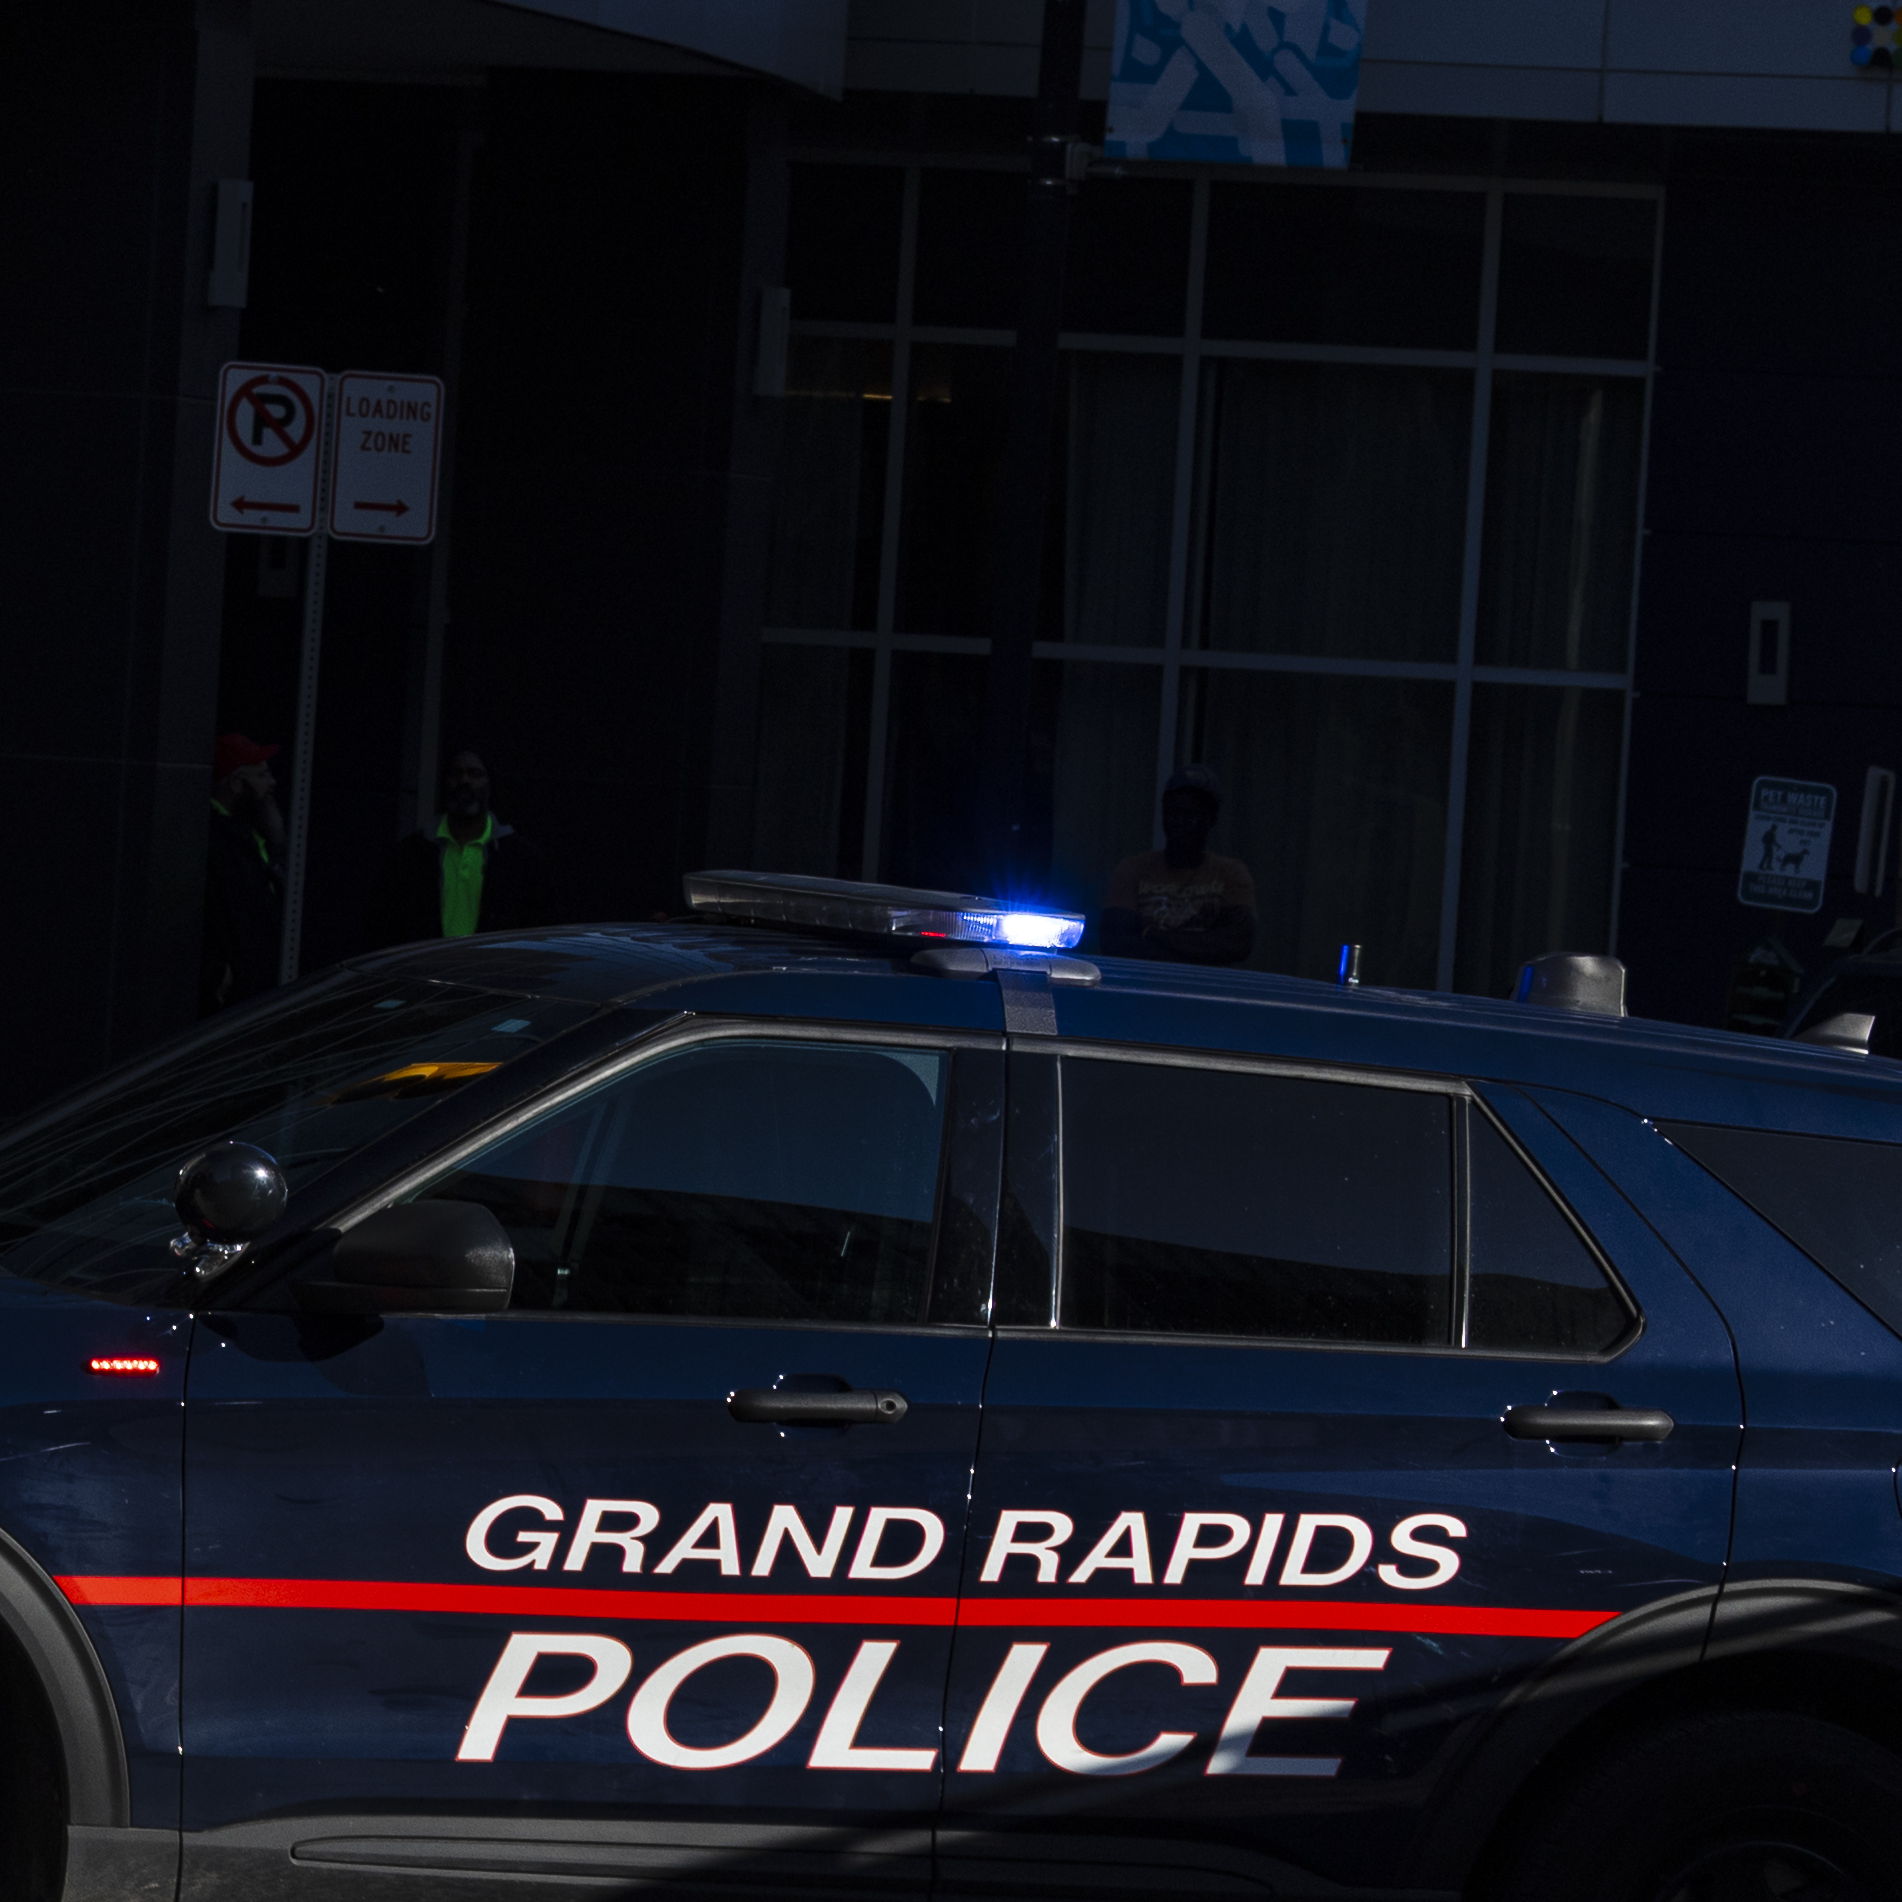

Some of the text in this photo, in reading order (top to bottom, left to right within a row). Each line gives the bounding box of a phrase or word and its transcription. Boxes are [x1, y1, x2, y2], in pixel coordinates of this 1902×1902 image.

[346, 396, 433, 424] LOADING
[360, 430, 413, 455] ZONE
[1760, 788, 1827, 809] PET WASTE
[464, 1492, 1470, 1591] GRAND RAPIDS
[455, 1630, 1392, 1779] POLICE
